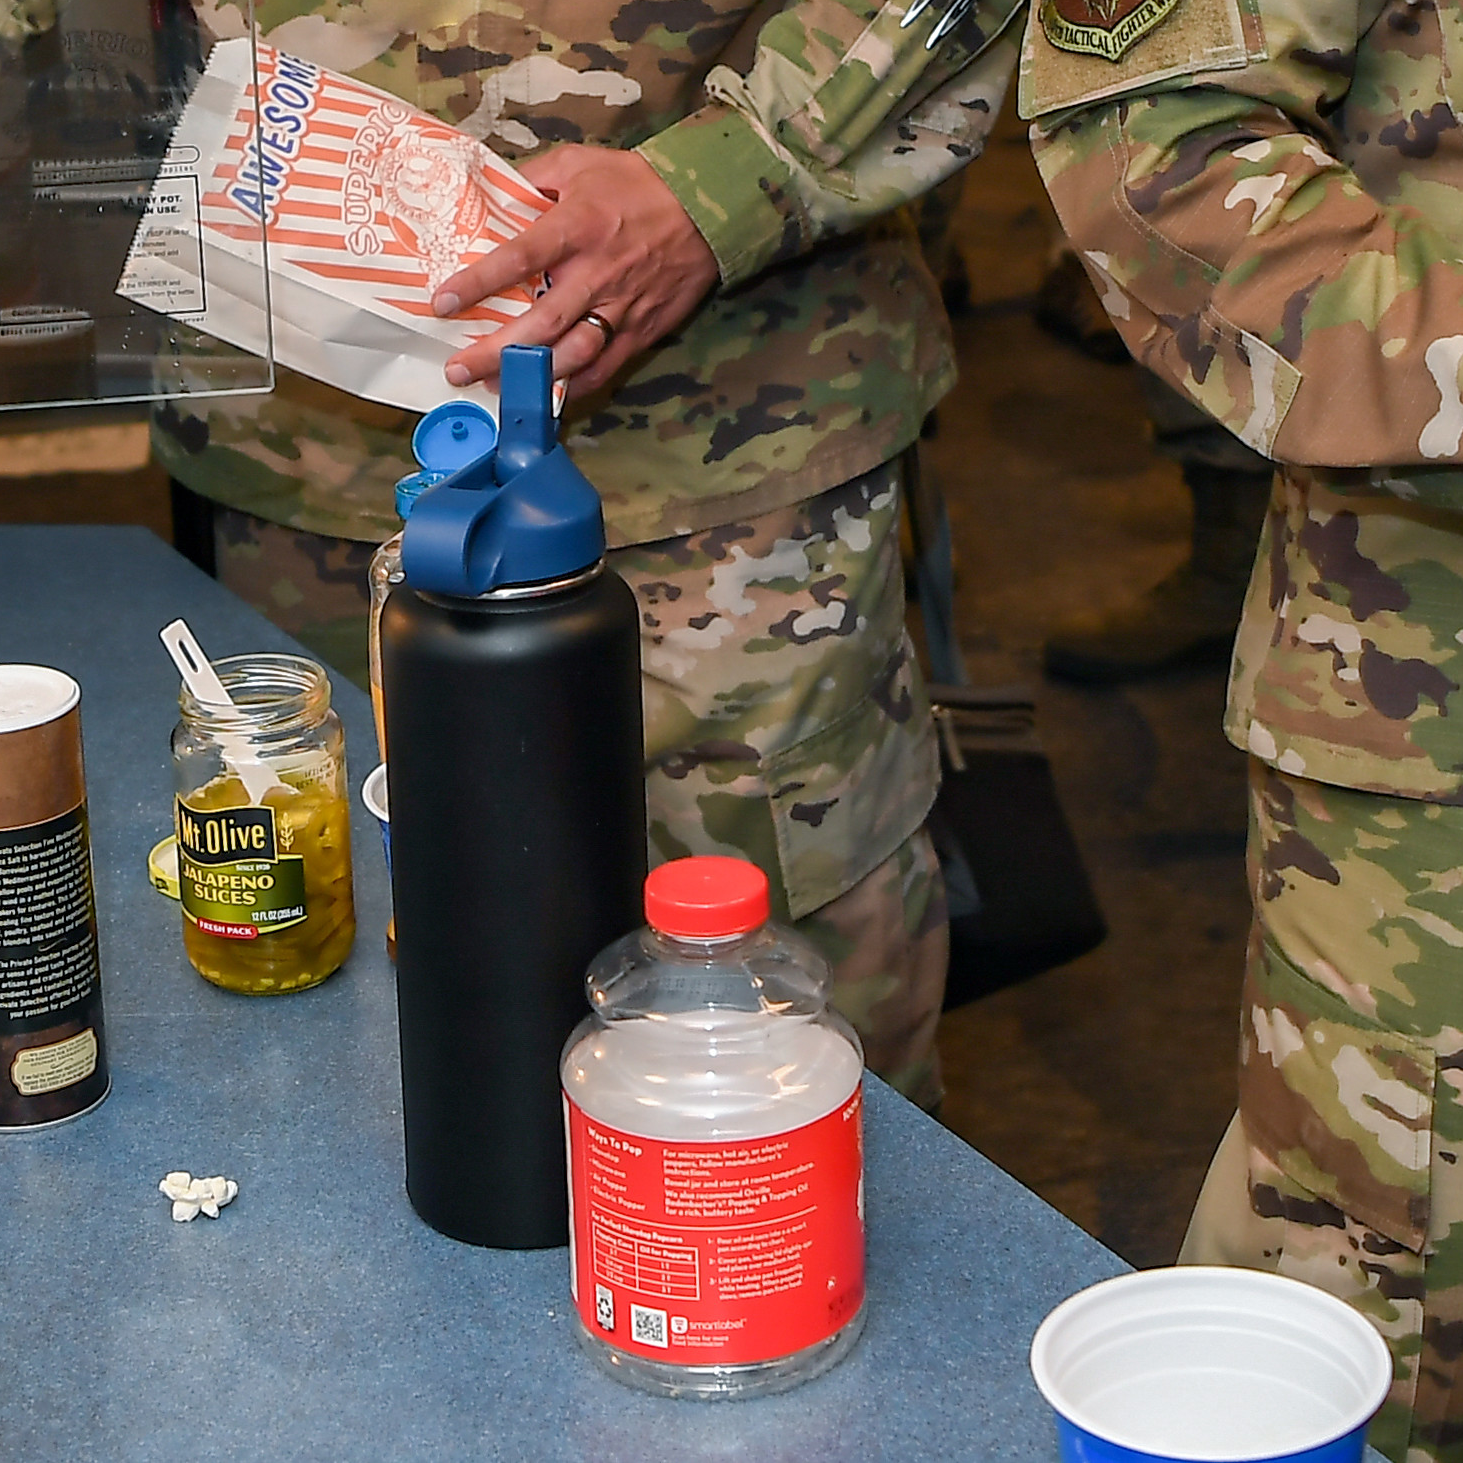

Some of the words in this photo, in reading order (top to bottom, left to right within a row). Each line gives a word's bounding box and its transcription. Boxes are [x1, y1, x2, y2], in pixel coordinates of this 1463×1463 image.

[1065, 27, 1112, 54] TACTICAL
[1111, 4, 1156, 54] FIGHTER
[161, 195, 182, 203] POT.
[14, 842, 42, 853] Selection
[7, 856, 20, 864] Salt
[183, 864, 274, 890] JALAPENO
[194, 884, 256, 905] SLICES
[251, 912, 259, 921] 12
[200, 921, 225, 931] FRESH
[227, 924, 252, 935] PACK
[10, 959, 32, 968] Private
[34, 952, 60, 964] Selection
[20, 997, 48, 1007] Selection
[588, 1126, 608, 1144] Ways
[609, 1137, 621, 1149] To
[622, 1141, 642, 1156] Pop
[663, 1149, 676, 1157] For
[723, 1150, 737, 1158] hot
[761, 1142, 789, 1154] electric
[699, 1159, 723, 1167] follow
[690, 1179, 702, 1189] jar
[703, 1179, 718, 1187] and
[720, 1179, 739, 1187] store
[741, 1178, 749, 1186] at
[751, 1176, 770, 1184] room
[664, 1190, 678, 1198] We
[680, 1190, 695, 1199] also
[696, 1188, 743, 1199] recommend
[744, 1187, 770, 1196] Orville
[728, 1197, 760, 1207] Popping
[761, 1195, 768, 1203] &
[769, 1187, 797, 1201] Topping
[798, 1183, 808, 1193] Oil
[618, 1196, 645, 1210] Popper
[665, 1206, 677, 1215] for
[703, 1208, 733, 1217] buttery
[652, 1232, 683, 1243] Popcorn
[663, 1250, 692, 1261] Popping
